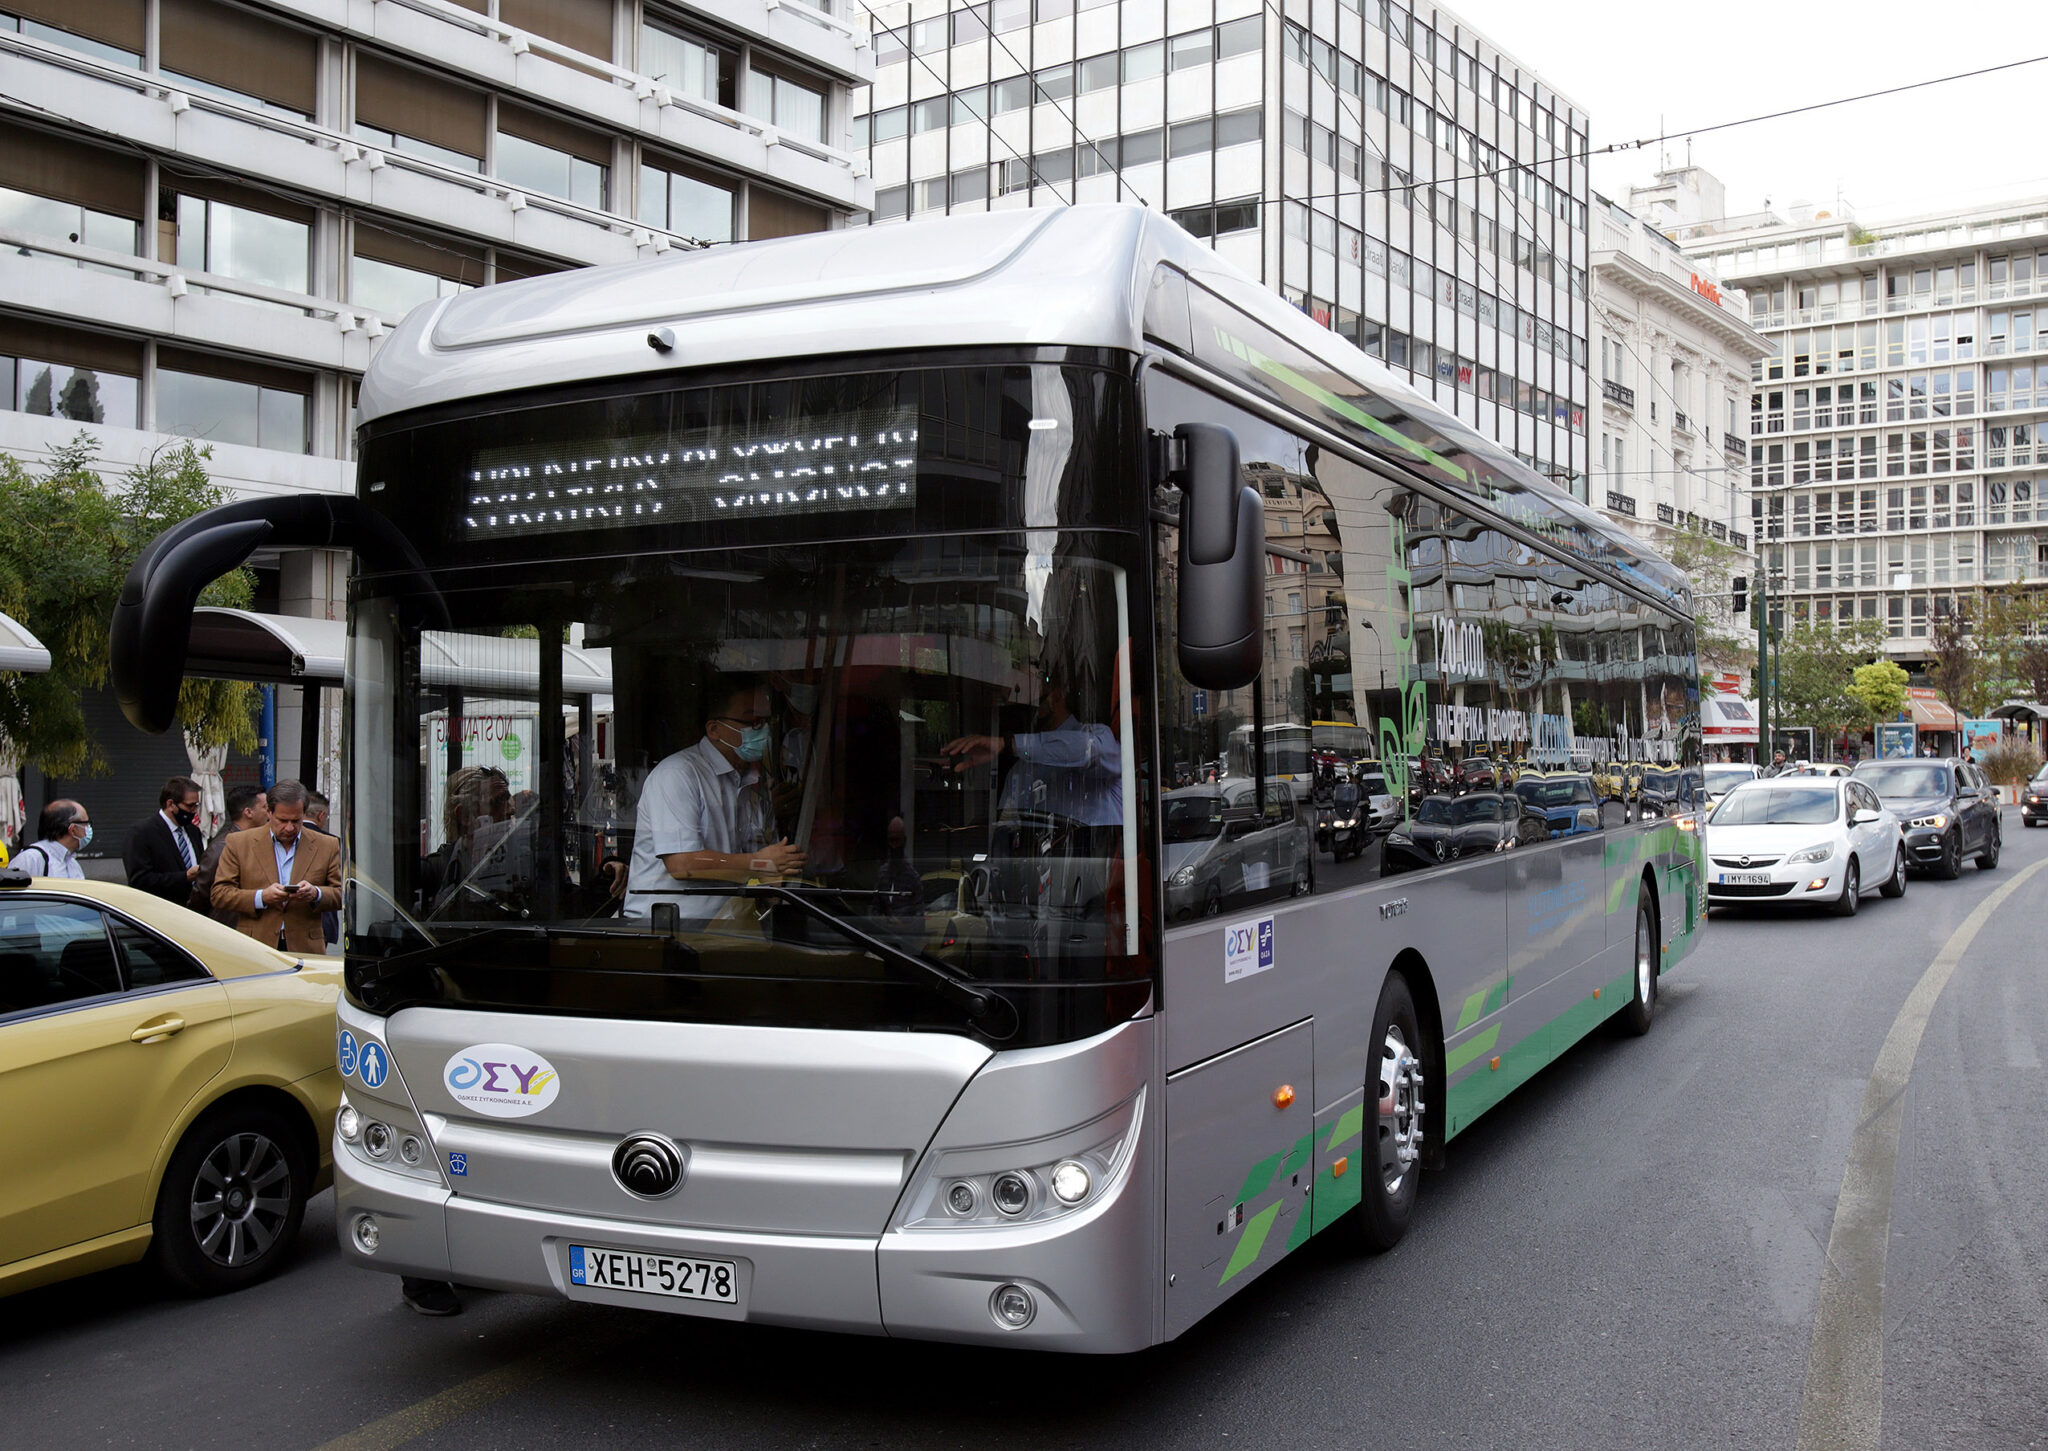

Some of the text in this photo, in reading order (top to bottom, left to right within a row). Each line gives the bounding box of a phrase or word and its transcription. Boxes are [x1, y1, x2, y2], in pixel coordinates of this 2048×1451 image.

[1691, 272, 1723, 307] Public
[1486, 475, 1516, 520] Zero
[1432, 615, 1484, 678] 120.000
[457, 1094, 478, 1102] ΟΔΙΚΕΣ
[572, 1267, 585, 1279] GR
[592, 1252, 731, 1298] XEH-5278
